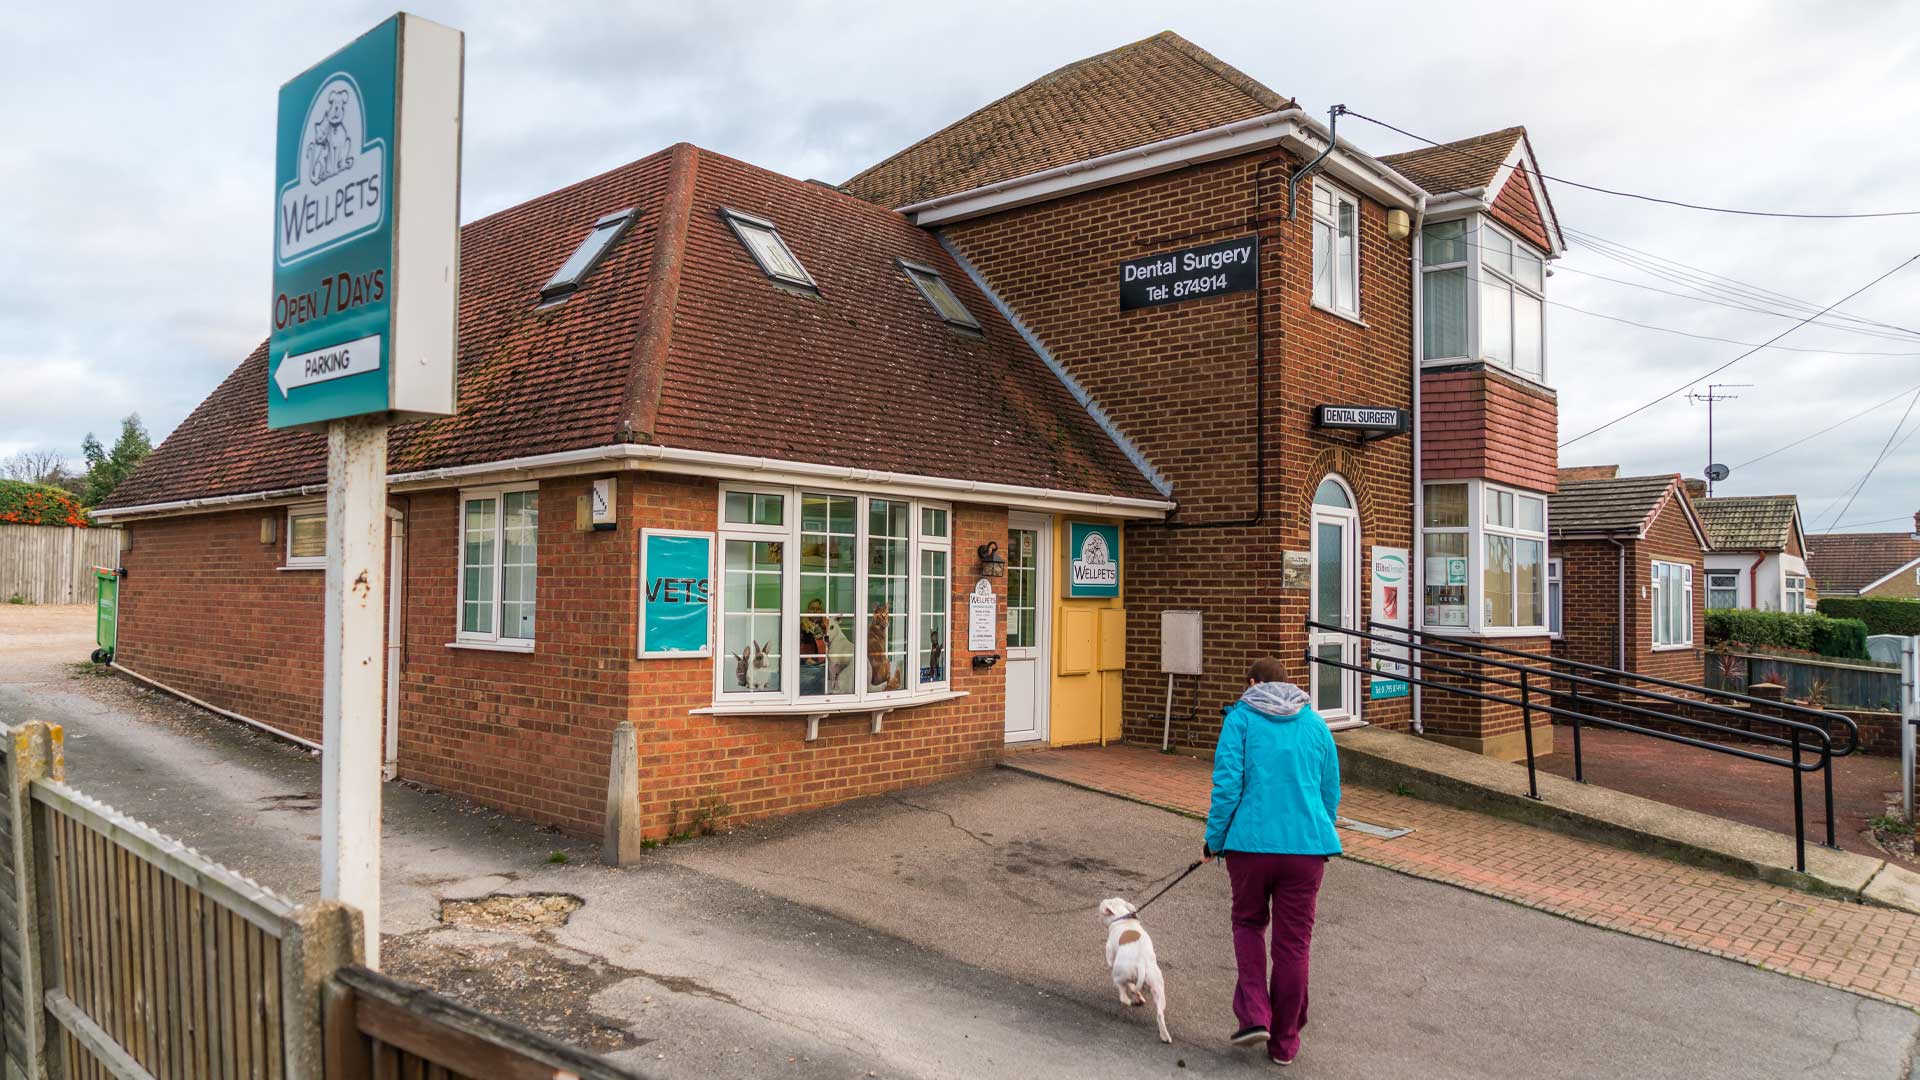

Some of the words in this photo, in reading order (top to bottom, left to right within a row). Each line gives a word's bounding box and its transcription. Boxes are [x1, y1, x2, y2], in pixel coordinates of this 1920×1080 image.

[283, 174, 380, 245] WELLPETS
[1124, 256, 1177, 282] Dental
[1183, 246, 1251, 271] Surgery
[275, 294, 317, 330] OPEN
[322, 278, 333, 316] 7
[337, 269, 385, 313] DAYS
[1146, 286, 1169, 302] Tel:
[1173, 273, 1228, 297] 874914
[305, 350, 350, 378] PARKING
[1326, 409, 1357, 423] DENTAL
[1358, 410, 1395, 424] SURGERY
[1074, 566, 1115, 581] WELLPETS
[971, 595, 996, 604] WELLPETS
